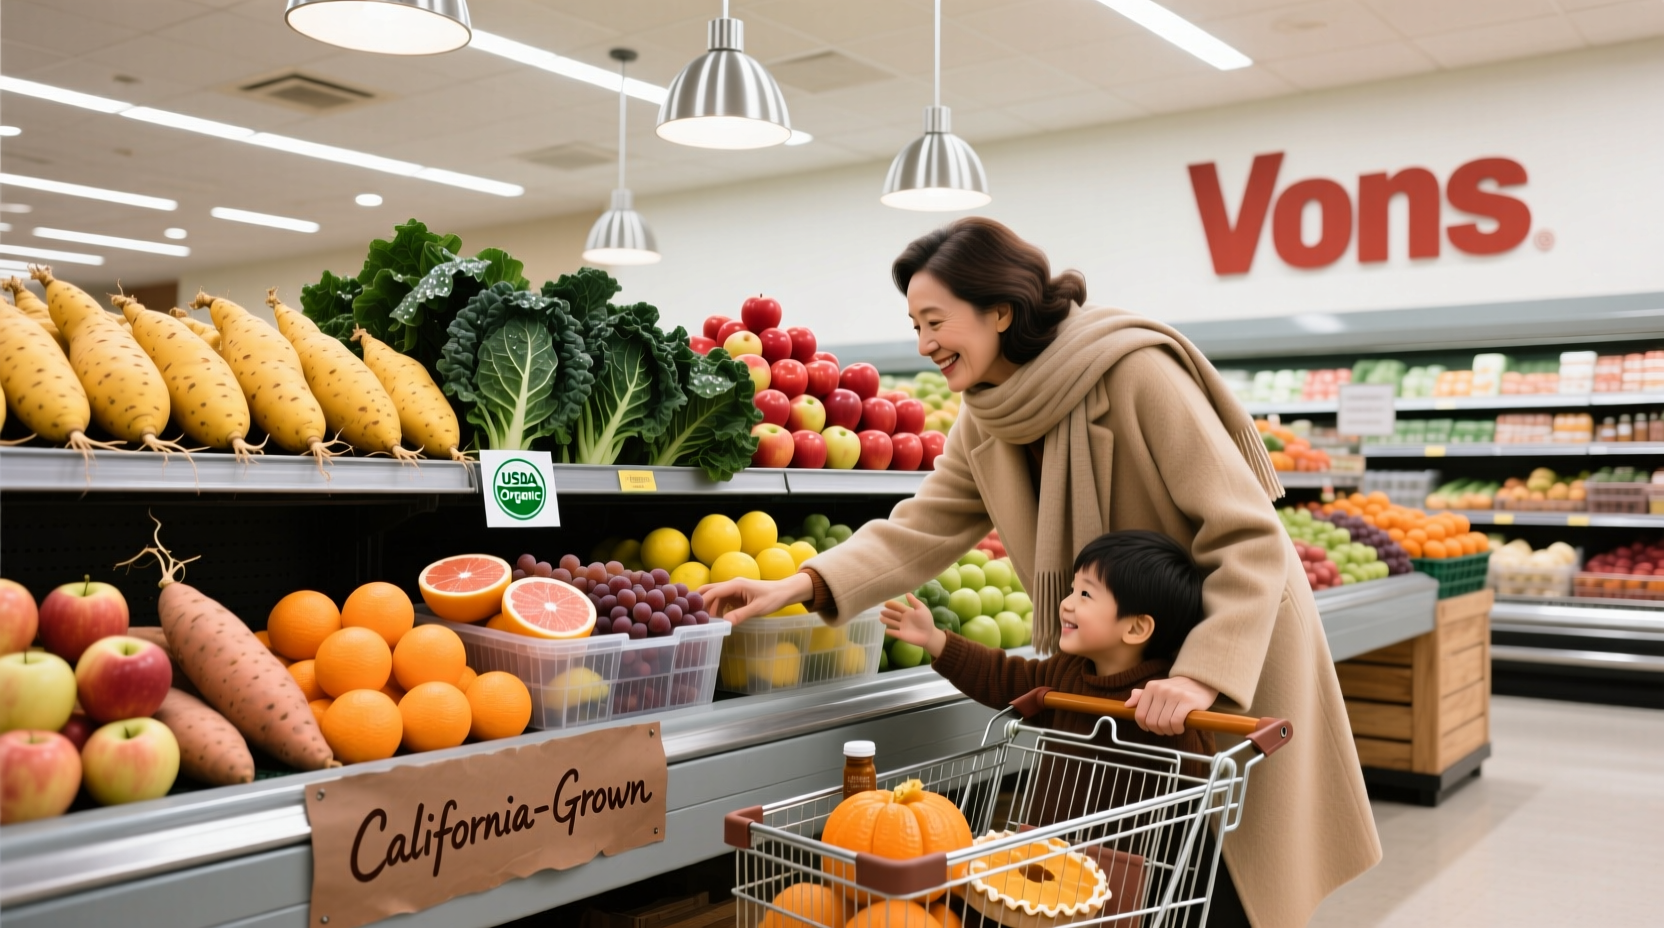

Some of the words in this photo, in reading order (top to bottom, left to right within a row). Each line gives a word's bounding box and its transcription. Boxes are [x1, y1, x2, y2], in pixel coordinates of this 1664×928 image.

[1187, 151, 1533, 276] Vons
[501, 471, 538, 485] USDA
[350, 768, 653, 882] California-Grown
